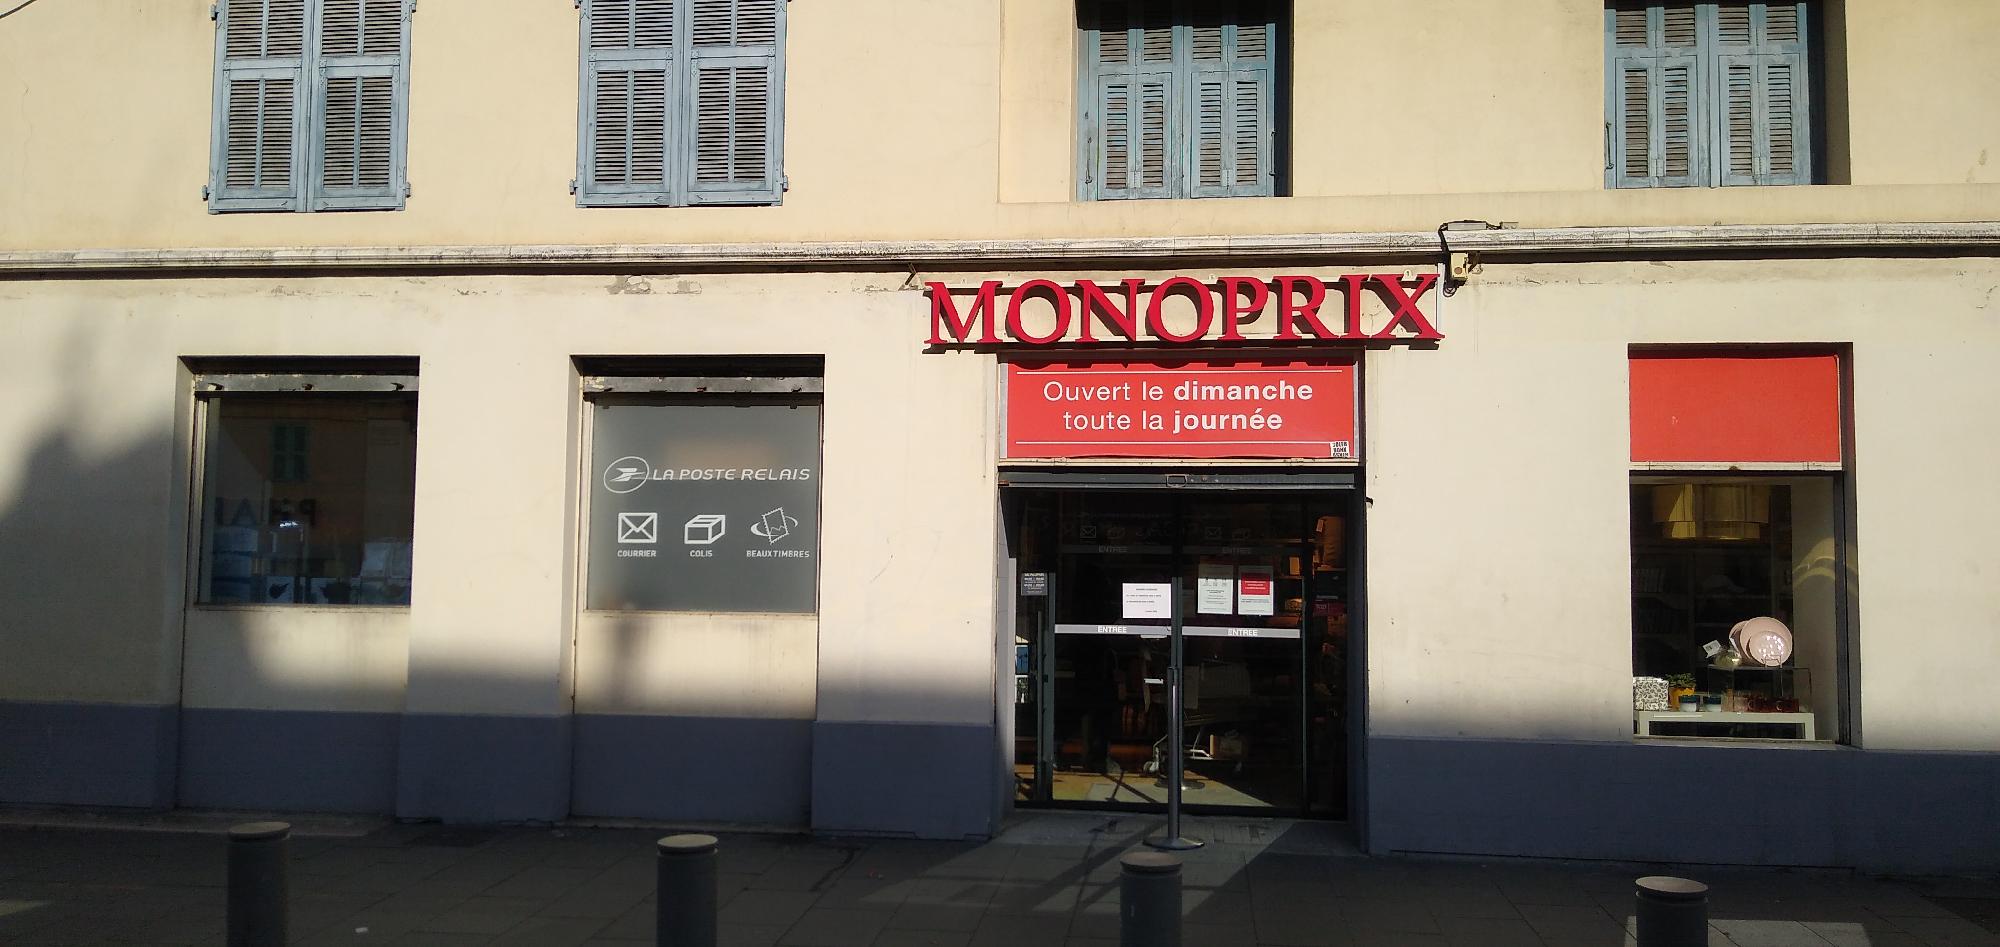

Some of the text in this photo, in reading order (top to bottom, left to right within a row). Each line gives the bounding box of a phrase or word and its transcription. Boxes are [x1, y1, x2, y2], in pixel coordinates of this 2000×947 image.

[923, 272, 1446, 346] MONOPRIX
[1043, 379, 1314, 402] Ouvert le dimanche
[1062, 407, 1284, 434] toute la journée
[652, 467, 811, 481] LA POSTE RELAIS
[617, 549, 657, 558] COURRIER
[689, 549, 713, 558] COLIS
[1097, 626, 1128, 634] ENTREE
[1227, 629, 1258, 637] ENTREE
